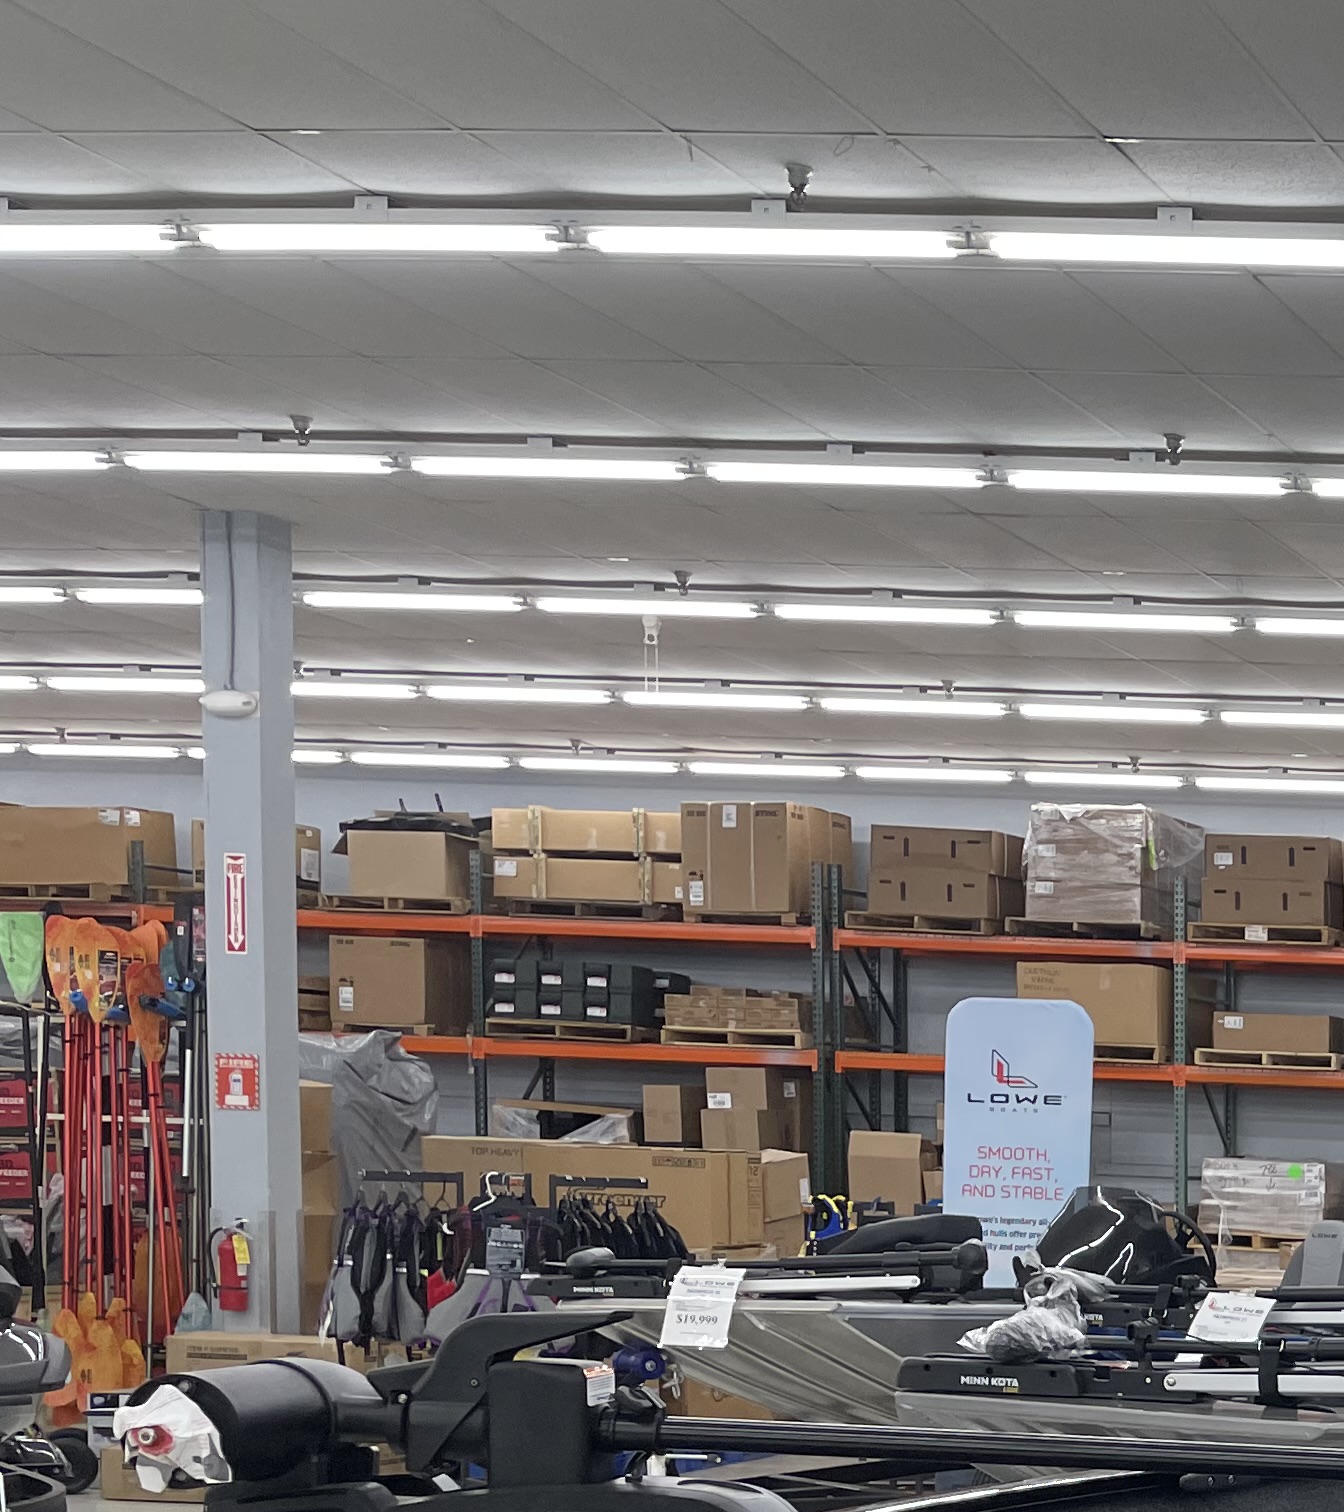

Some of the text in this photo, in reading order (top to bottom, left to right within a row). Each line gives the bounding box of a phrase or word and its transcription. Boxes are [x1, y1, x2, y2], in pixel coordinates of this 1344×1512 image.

[966, 1092, 1063, 1106] LOWE
[976, 1145, 1051, 1163] SMOOTH,
[968, 1164, 1058, 1183] DRY, FAST,
[961, 1183, 1065, 1201] AND STABLE
[675, 1313, 719, 1326] $19,999
[960, 1375, 1019, 1387] MINN KOTA
